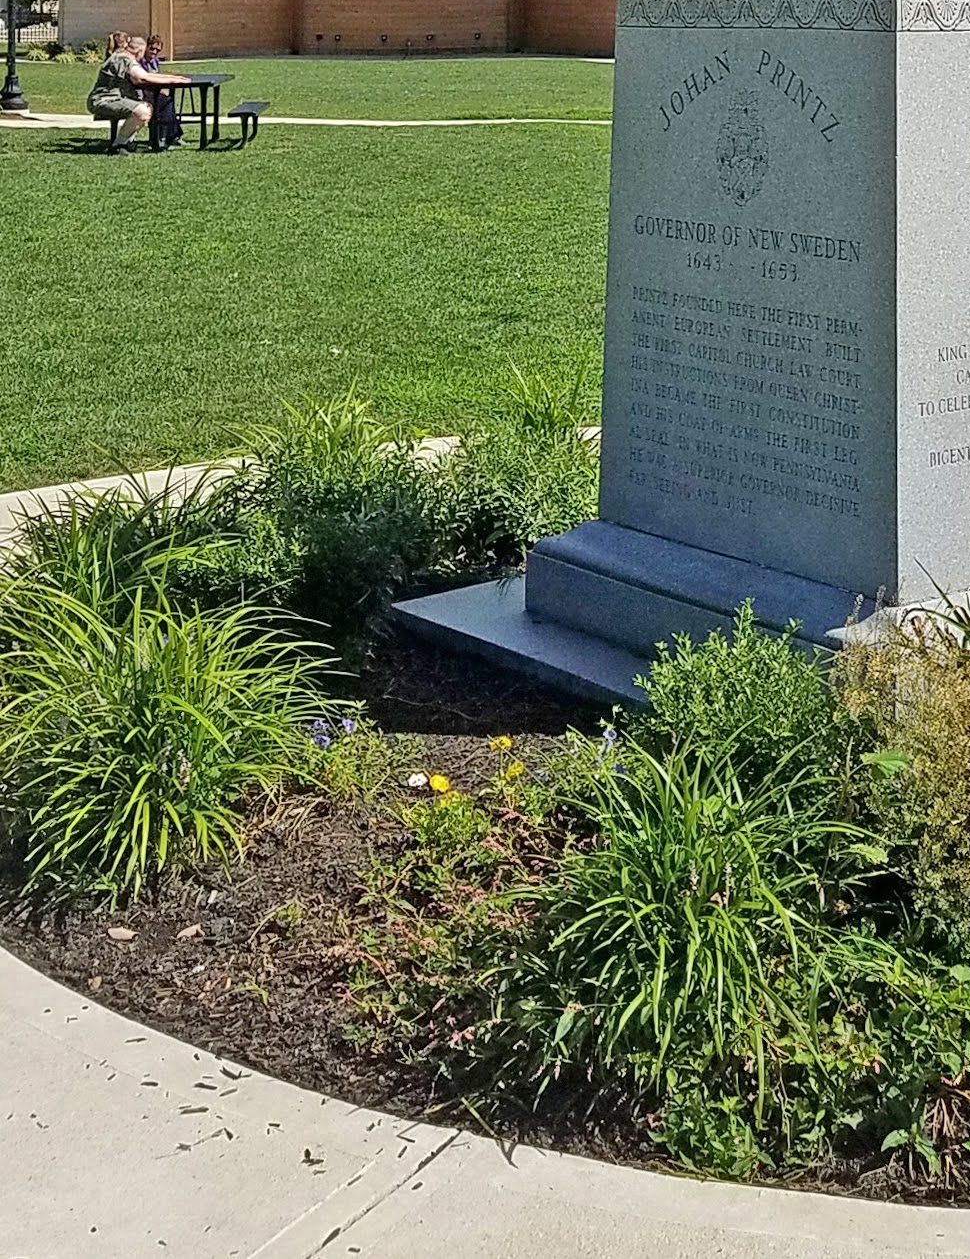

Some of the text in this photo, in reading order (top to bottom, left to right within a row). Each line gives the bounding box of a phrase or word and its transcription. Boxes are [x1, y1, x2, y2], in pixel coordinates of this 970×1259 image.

[658, 49, 840, 143] JOHAN PRINTZ
[634, 214, 861, 263] GOVERNOR OF NEW SWEDEN
[686, 251, 798, 283] 1643 1653
[632, 286, 668, 306] PRINTZ
[672, 293, 722, 314] FOUNDED
[727, 301, 756, 319] HERE
[761, 306, 783, 324] THE
[787, 309, 820, 331] FIRST
[631, 310, 861, 363] ANENT EUROPEAN SETTLEMENT BUILT
[631, 332, 861, 389] THE FIRST CAPITOL CHURCH LAW COURT
[937, 343, 967, 363] KING
[630, 354, 648, 371] HIS
[650, 357, 728, 388] INSTRUCTIONS
[734, 374, 764, 395] FROM
[769, 382, 808, 402] QUEEN
[630, 378, 860, 440] INA BECAME THE FIRST CONSTITUTION
[631, 402, 652, 418] AND
[655, 406, 673, 424] HIS
[678, 411, 707, 431] COAT
[711, 419, 724, 434] OF
[729, 424, 759, 442] ARMS
[766, 430, 789, 449] THE
[793, 436, 828, 458] FIRST
[917, 400, 935, 417] TO
[629, 446, 644, 463] HE
[740, 473, 801, 503] GOVERNOR
[805, 489, 860, 519] DECISIVE
[728, 445, 739, 463] IS
[743, 449, 767, 469] NOW
[772, 456, 860, 493] PENNSYLVANIA
